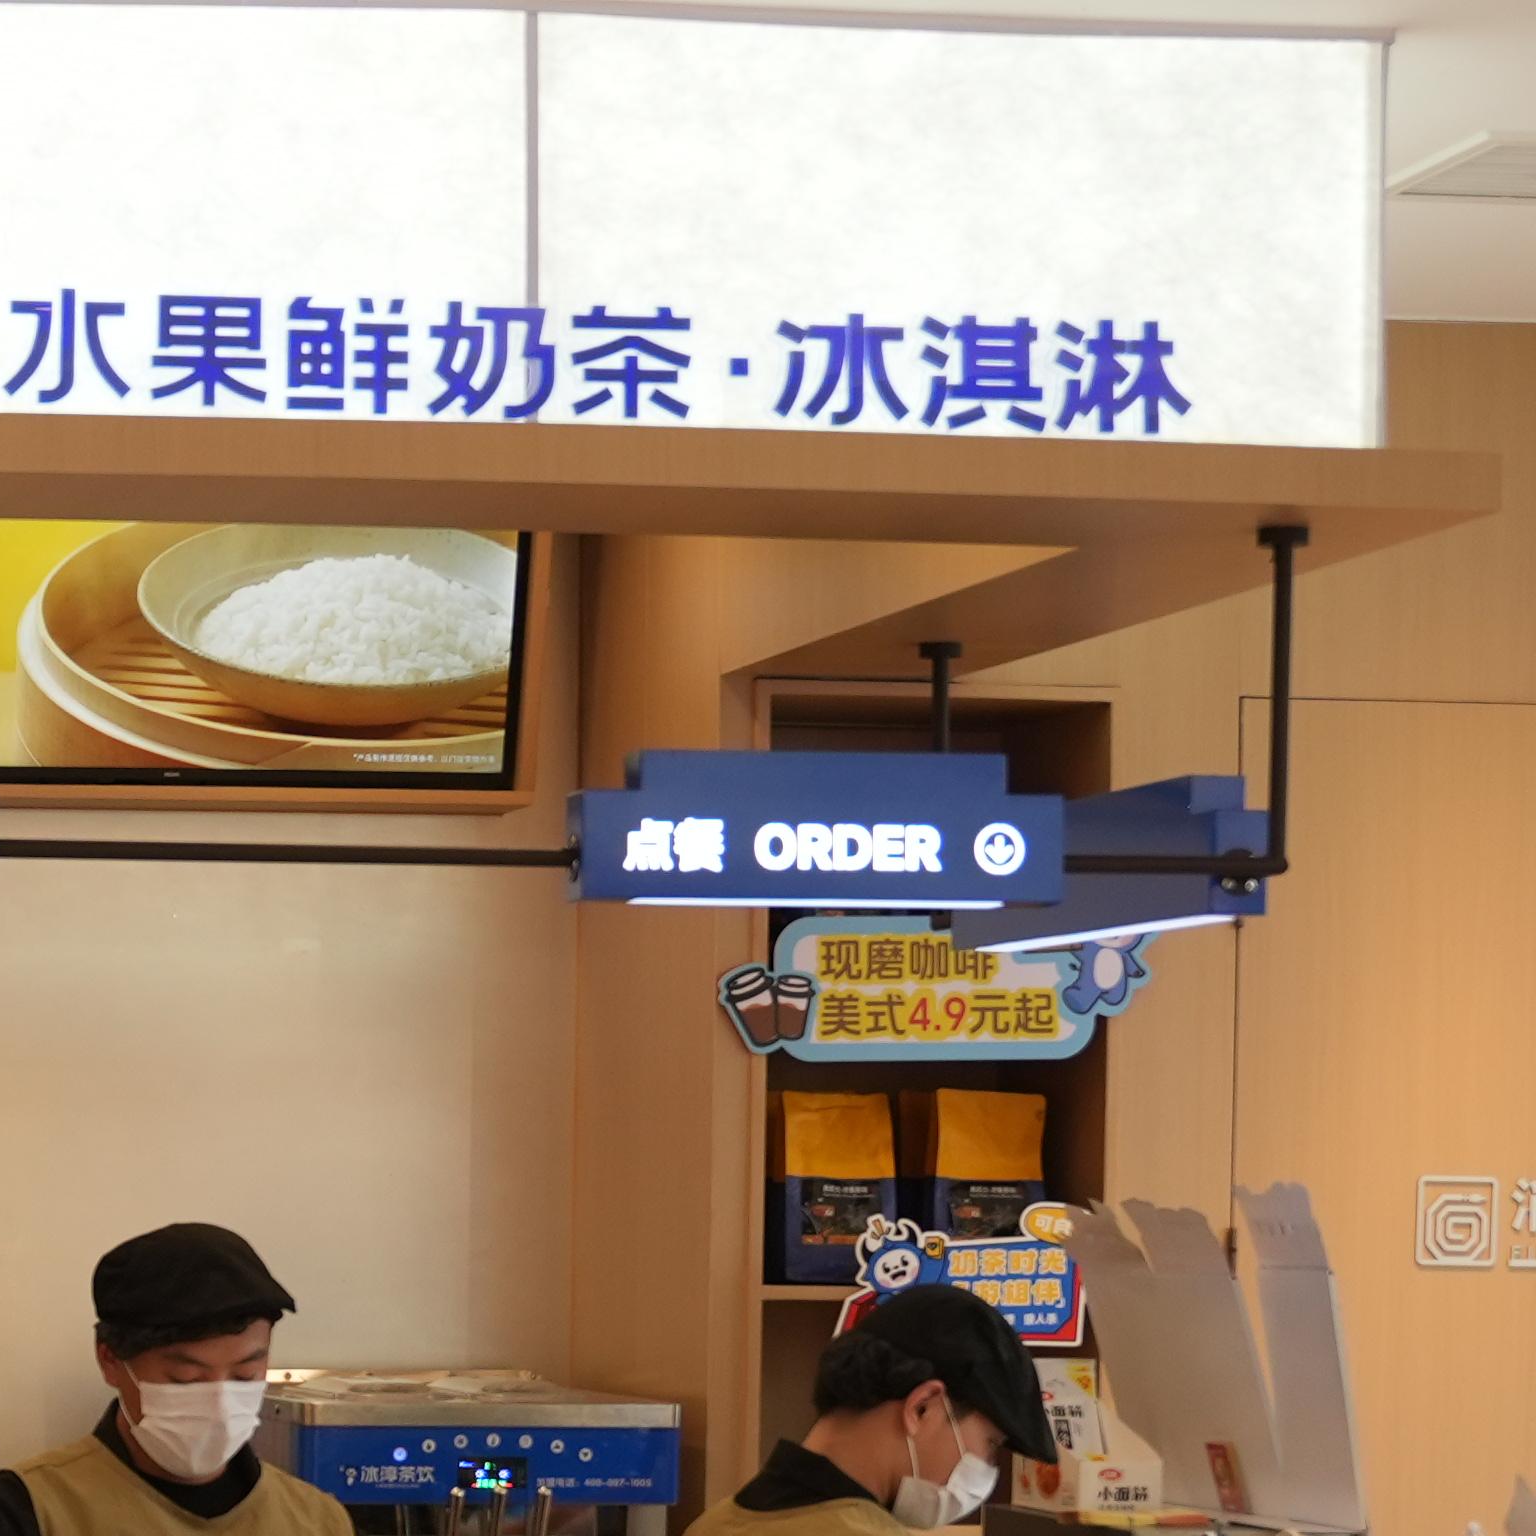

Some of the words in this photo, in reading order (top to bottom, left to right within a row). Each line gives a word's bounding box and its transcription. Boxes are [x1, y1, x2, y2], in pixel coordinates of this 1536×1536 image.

[3, 288, 1194, 436] 水果鲜奶茶·冰淇淋
[622, 816, 726, 874] 点餐
[753, 822, 943, 873] ORDER
[819, 938, 998, 981] 现磨咖啡
[819, 994, 1056, 1037] 美式4.9元起
[947, 1247, 1068, 1277] 奶茶时光
